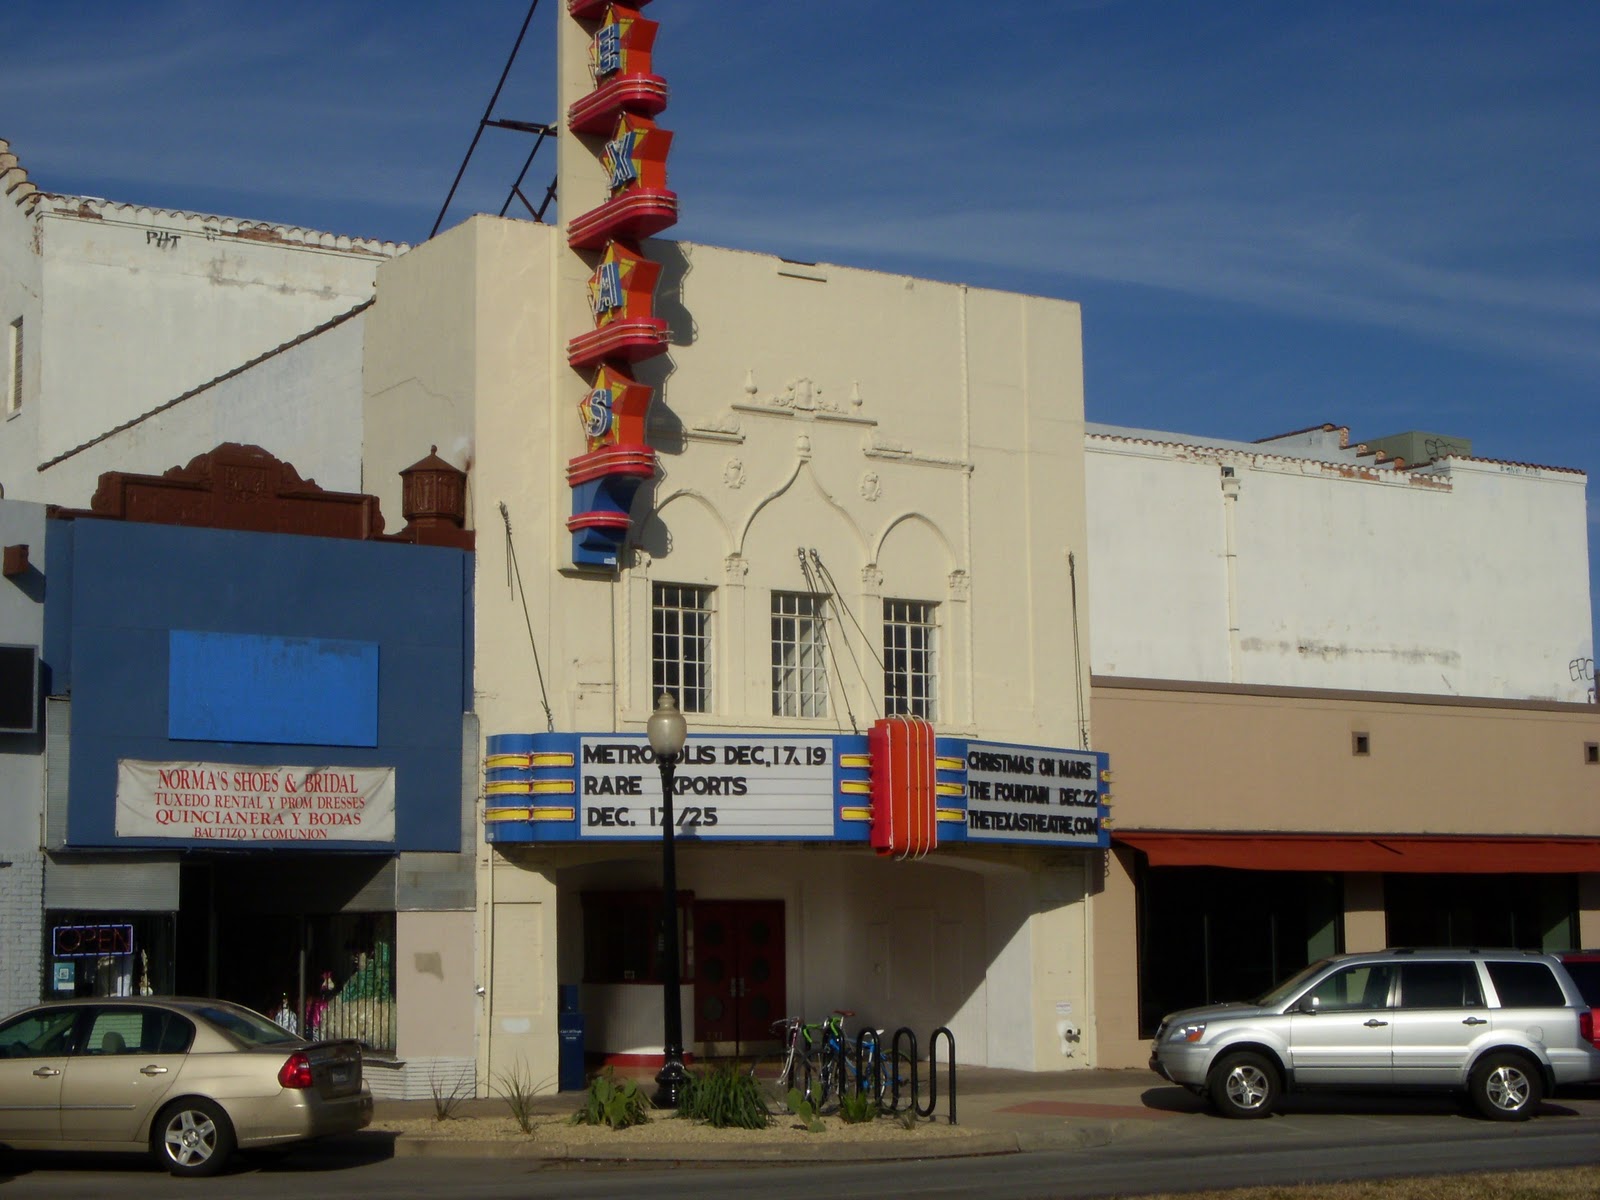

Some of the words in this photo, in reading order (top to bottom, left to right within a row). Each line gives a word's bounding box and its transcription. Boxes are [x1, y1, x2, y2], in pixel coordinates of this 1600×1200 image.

[583, 745, 716, 764] METROOLIS
[968, 751, 1034, 775] CHRISTMAS
[1039, 758, 1055, 777] ON
[1059, 760, 1091, 780] MARS
[158, 769, 229, 791] NORMA'S
[233, 772, 279, 792] SHOES
[285, 773, 297, 793] &
[305, 773, 358, 793] BRIDAL
[584, 776, 642, 795] RARE
[672, 776, 747, 795] XPORTS
[154, 792, 210, 807] TUXEDO
[215, 795, 263, 809] RENTAL
[268, 797, 275, 809] Y
[280, 797, 312, 809] PROM
[317, 797, 365, 809] DRESSES
[968, 781, 990, 800] THE
[995, 783, 1049, 804] FOUNTAIN
[155, 809, 284, 825] QUINCIANERA
[292, 813, 301, 825] Y
[309, 813, 361, 825] BODAS
[588, 807, 635, 827] DEC.
[194, 827, 247, 838] BAUTIZO
[251, 829, 258, 838] Y
[263, 829, 328, 839] COMUNION
[59, 928, 131, 951] OPEN
